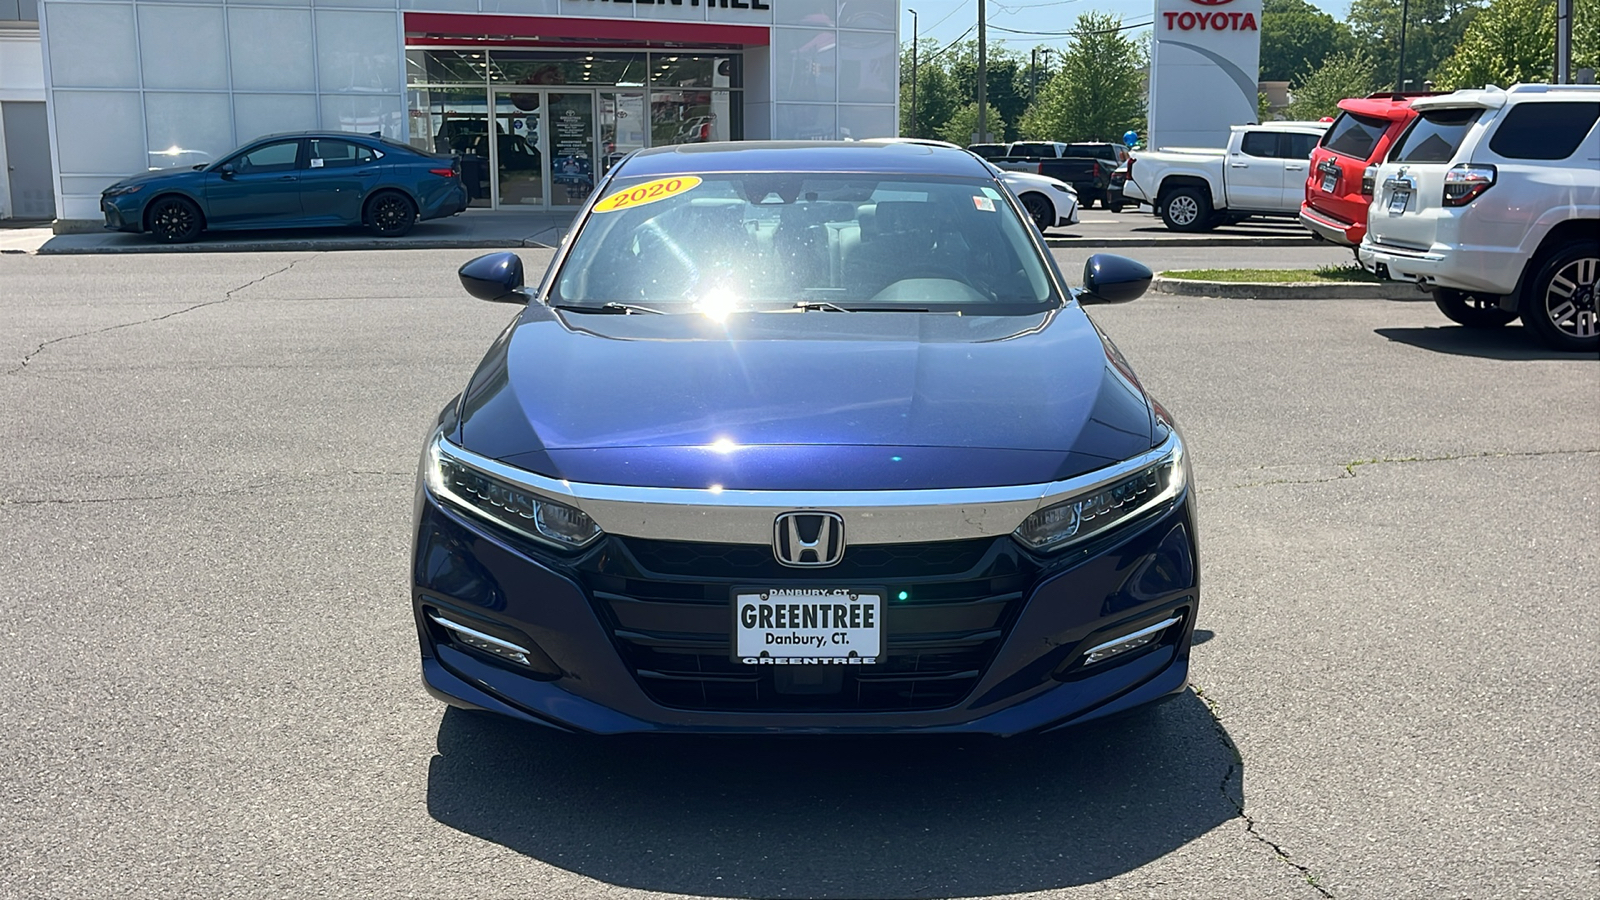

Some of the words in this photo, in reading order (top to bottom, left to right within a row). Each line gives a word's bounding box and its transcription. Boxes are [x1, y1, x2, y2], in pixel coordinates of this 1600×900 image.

[1163, 12, 1257, 31] TOYOTA
[614, 179, 682, 208] 2020
[770, 588, 829, 597] DANBURY,
[833, 588, 850, 596] CT
[741, 604, 875, 629] GREENTREE
[765, 632, 827, 648] Danbury,
[831, 633, 849, 645] CT.
[742, 657, 876, 665] GREENTREE
